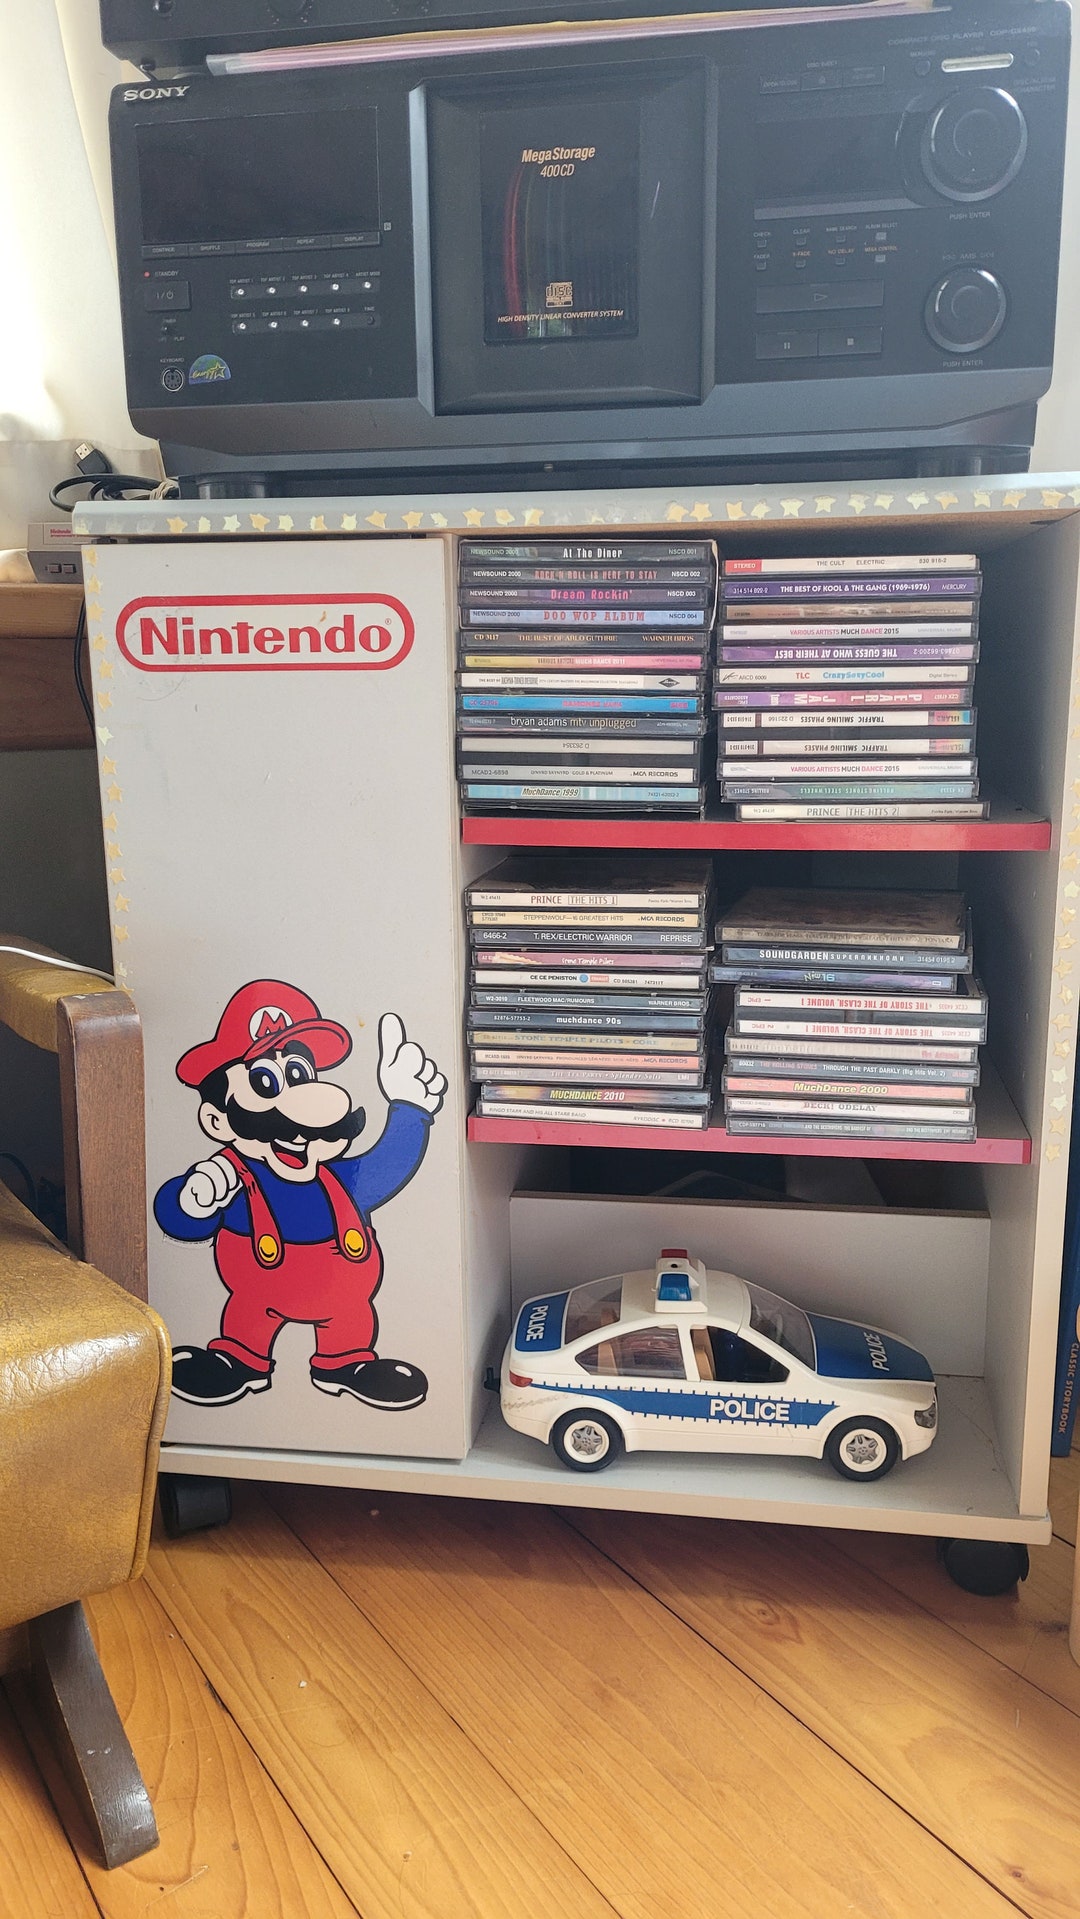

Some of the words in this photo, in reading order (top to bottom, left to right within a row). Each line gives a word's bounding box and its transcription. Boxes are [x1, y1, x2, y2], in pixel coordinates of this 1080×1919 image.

[124, 86, 190, 101] SONY
[540, 163, 575, 178] 400CD
[969, 211, 991, 219] ENTER
[497, 315, 514, 323] HIGH
[514, 313, 540, 322] DENSITY
[540, 312, 562, 321] LINEAR
[562, 310, 599, 319] CONVERTER
[599, 309, 624, 318] SYSTEM
[563, 548, 575, 559] At
[577, 548, 593, 559] The
[597, 548, 623, 559] Diner
[534, 570, 555, 580] ROCK
[567, 570, 587, 580] ROLL
[590, 570, 599, 580] IS
[602, 570, 622, 580] HERE
[625, 570, 635, 580] TO
[639, 570, 658, 580] STAY
[794, 585, 811, 593] BEST
[865, 584, 887, 592] GANG
[888, 583, 930, 593] (1969-1976)
[551, 590, 585, 600] Dream
[591, 590, 632, 600] Rockin'
[543, 611, 566, 621] DOO
[573, 611, 597, 621] WOP
[604, 611, 645, 621] ALBUM
[140, 614, 392, 656] Nintendo
[774, 650, 794, 659] BEST
[795, 650, 819, 658] THEIR
[820, 649, 832, 658] AT
[832, 649, 854, 658] WHO
[855, 648, 879, 657] GUESS
[880, 648, 897, 657] THE
[850, 694, 923, 703] PEARL
[510, 717, 535, 728] bryan
[537, 717, 567, 727] adams
[570, 718, 587, 727] mtv
[589, 718, 637, 729] unplugged
[522, 788, 561, 796] MuchDance
[562, 789, 579, 797] 1999
[806, 808, 840, 816] PRINCE
[849, 808, 865, 816] THE
[868, 808, 889, 816] HITS
[531, 896, 562, 904] PRINCE
[570, 896, 586, 904] THE
[588, 896, 608, 905] HITS
[541, 933, 595, 941] REX/ELECTRIC
[596, 933, 633, 941] WARRIOR
[660, 934, 692, 942] REPRISE
[760, 950, 829, 960] SOUNDGARDEN
[807, 998, 835, 1007] VOLUME
[864, 1000, 877, 1008] THE
[877, 1000, 889, 1009] OF
[891, 1001, 913, 1010] STORY
[916, 1002, 929, 1010] THE
[556, 1016, 602, 1024] muchdance
[256, 1010, 287, 1040] M
[812, 1025, 840, 1033] VOLUME
[869, 1027, 881, 1035] THE
[884, 1028, 893, 1036] OF
[895, 1028, 917, 1037] STORY
[920, 1029, 933, 1037] THE
[823, 1064, 849, 1072] THROUGH
[879, 1067, 901, 1075] DARKLY
[793, 1082, 857, 1093] MuchDance
[859, 1085, 889, 1094] 2000
[550, 1089, 602, 1100] MUCHDANCE
[604, 1091, 625, 1101] 2010
[803, 1102, 835, 1110] BECK!
[838, 1103, 878, 1112] ODELAY
[525, 1304, 548, 1343] POLICE
[863, 1332, 890, 1371] POLICE
[1067, 1342, 1079, 1377] CLASSIC
[710, 1400, 789, 1422] POLICE
[1058, 1380, 1074, 1434] STORYBOOK
